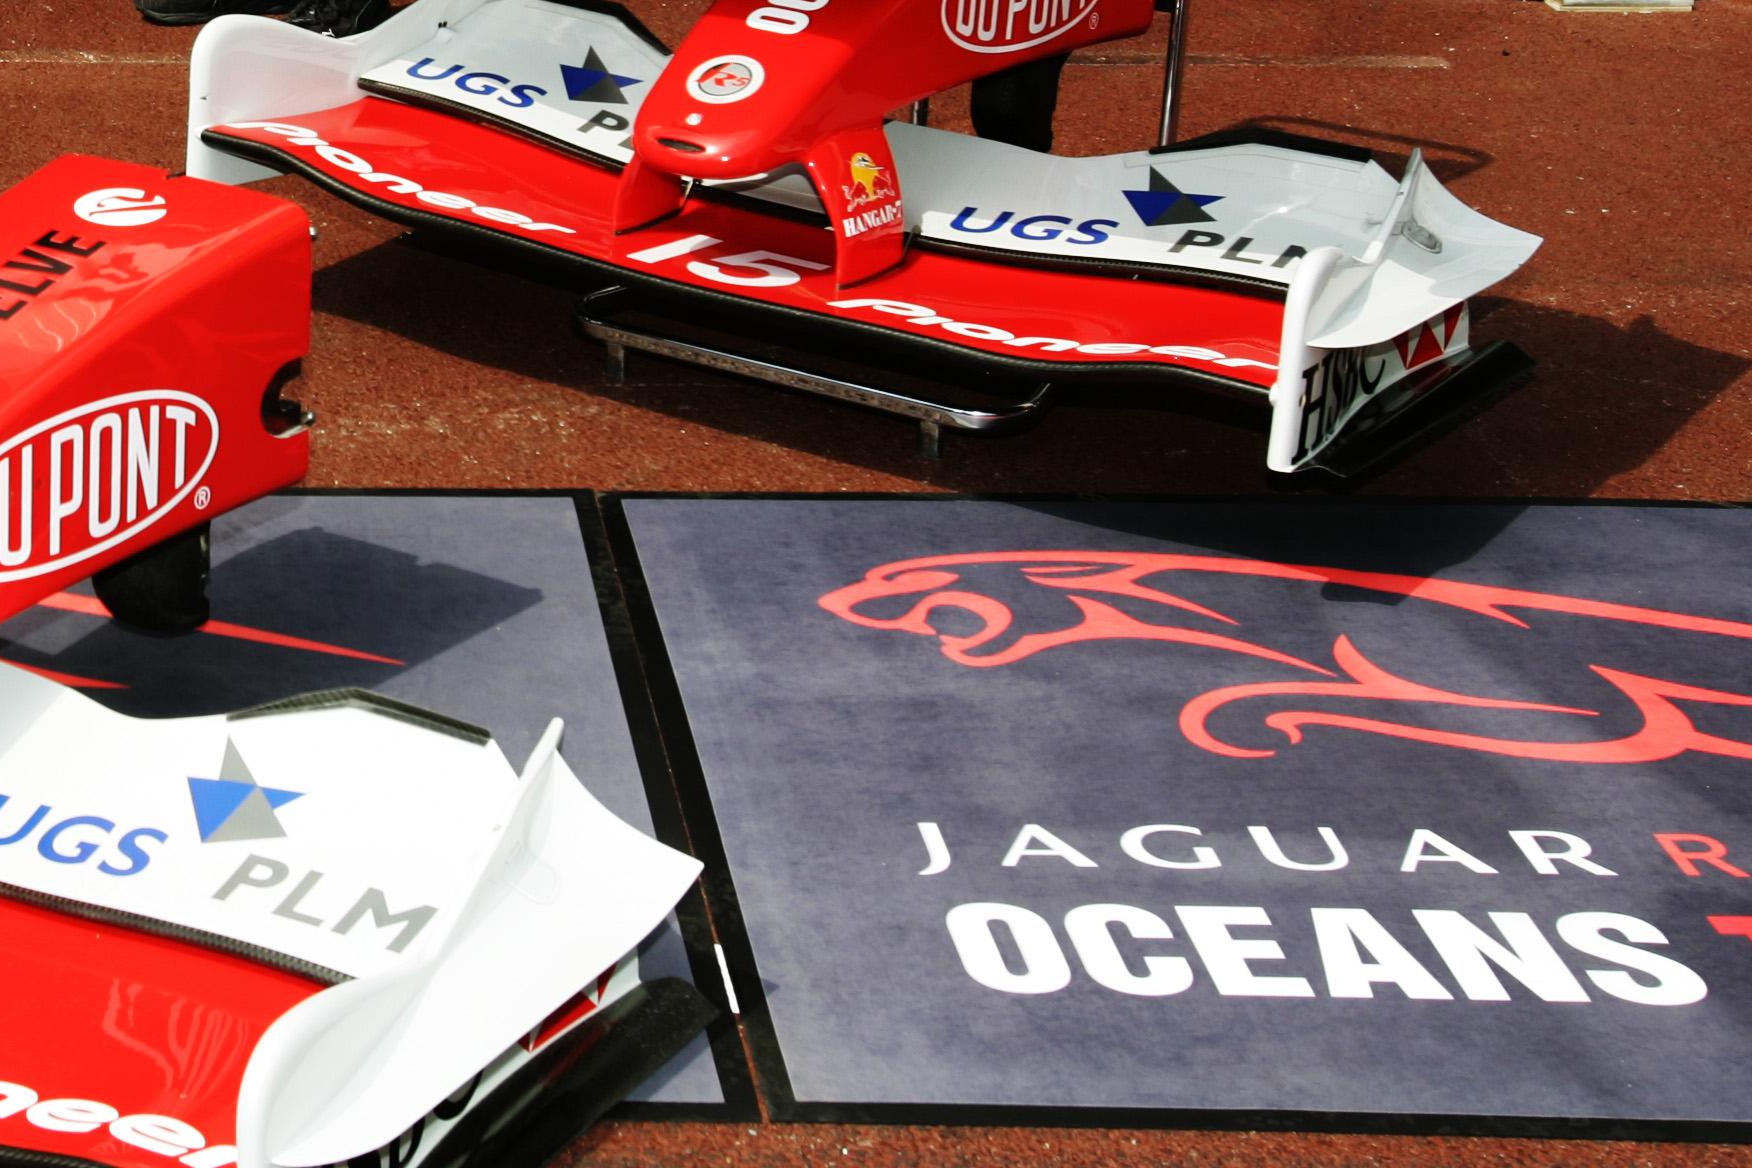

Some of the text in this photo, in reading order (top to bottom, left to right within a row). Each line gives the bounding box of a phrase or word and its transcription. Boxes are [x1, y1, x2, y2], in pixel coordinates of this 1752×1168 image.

[404, 56, 548, 109] UGS
[229, 122, 577, 234] Pioneer
[843, 199, 904, 239] HANGAR-7
[948, 205, 1121, 246] UGS
[625, 234, 834, 289] 15
[826, 297, 1280, 373] Pioneer
[916, 821, 1619, 877] JAGUAR
[211, 853, 439, 955] PLM
[944, 901, 1711, 1007] OCEANS
